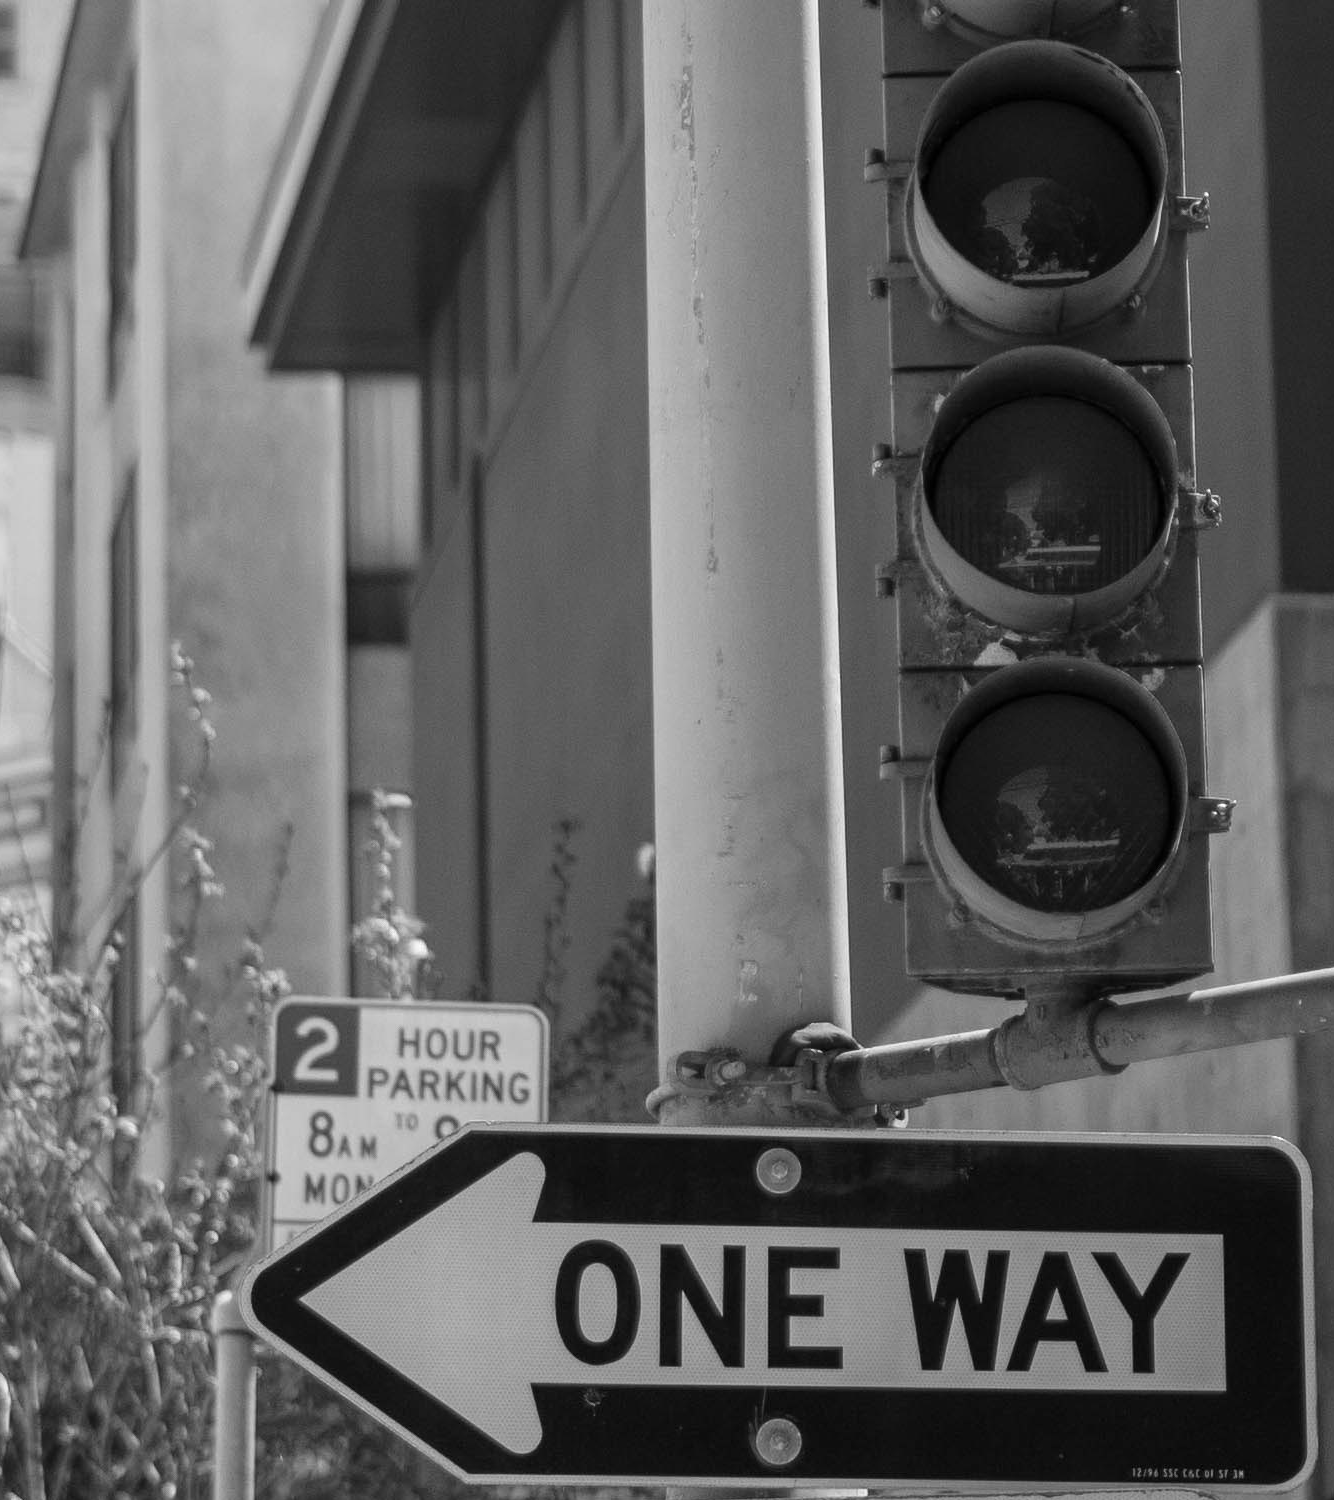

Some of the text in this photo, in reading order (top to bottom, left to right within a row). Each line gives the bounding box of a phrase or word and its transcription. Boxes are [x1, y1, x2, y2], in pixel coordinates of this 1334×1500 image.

[293, 1016, 502, 1083] 2 HOUR
[367, 1067, 531, 1106] PARKING
[394, 1111, 419, 1132] TO
[554, 1239, 1191, 1374] ONE WAY
